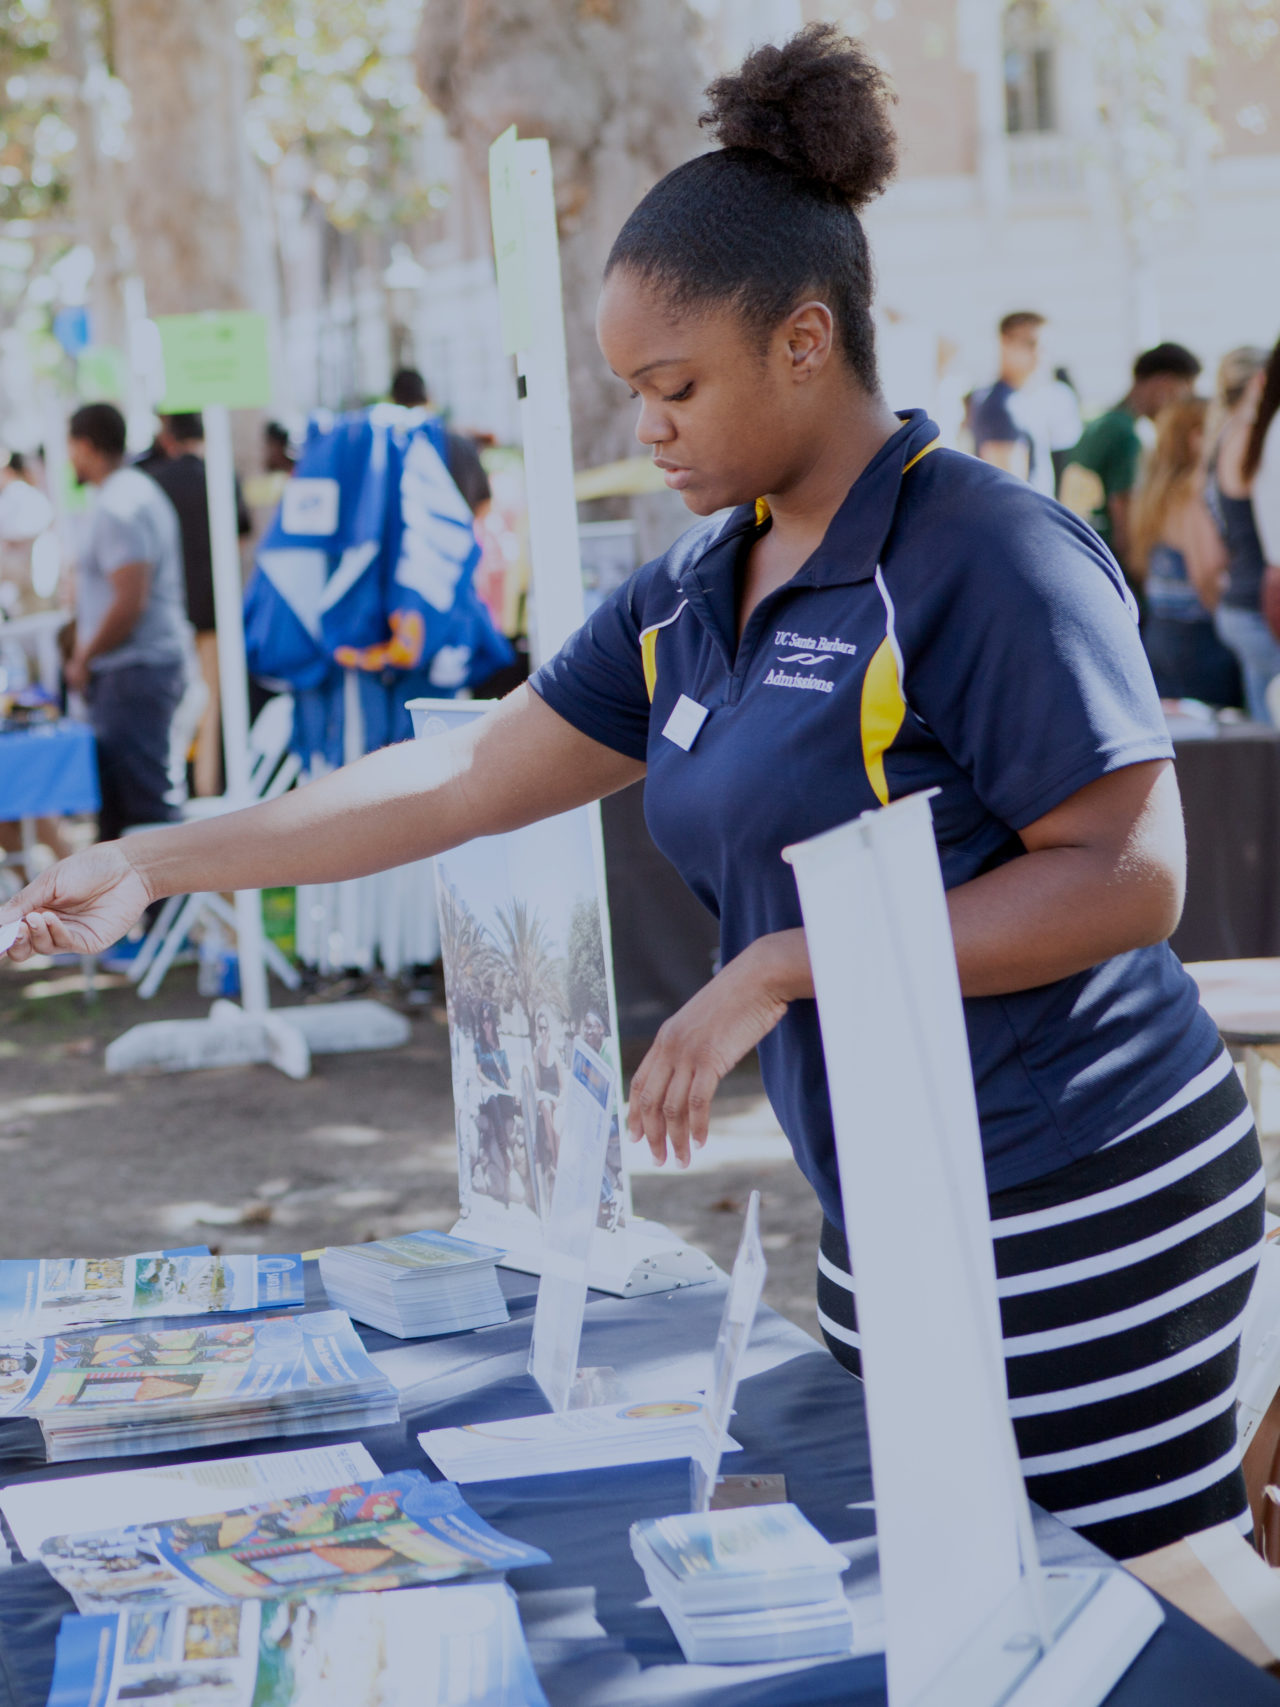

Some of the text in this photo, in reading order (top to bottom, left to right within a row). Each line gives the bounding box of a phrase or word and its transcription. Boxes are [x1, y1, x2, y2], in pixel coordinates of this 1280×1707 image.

[774, 631, 857, 655] UC Santa Barbara
[763, 668, 834, 693] Admissions
